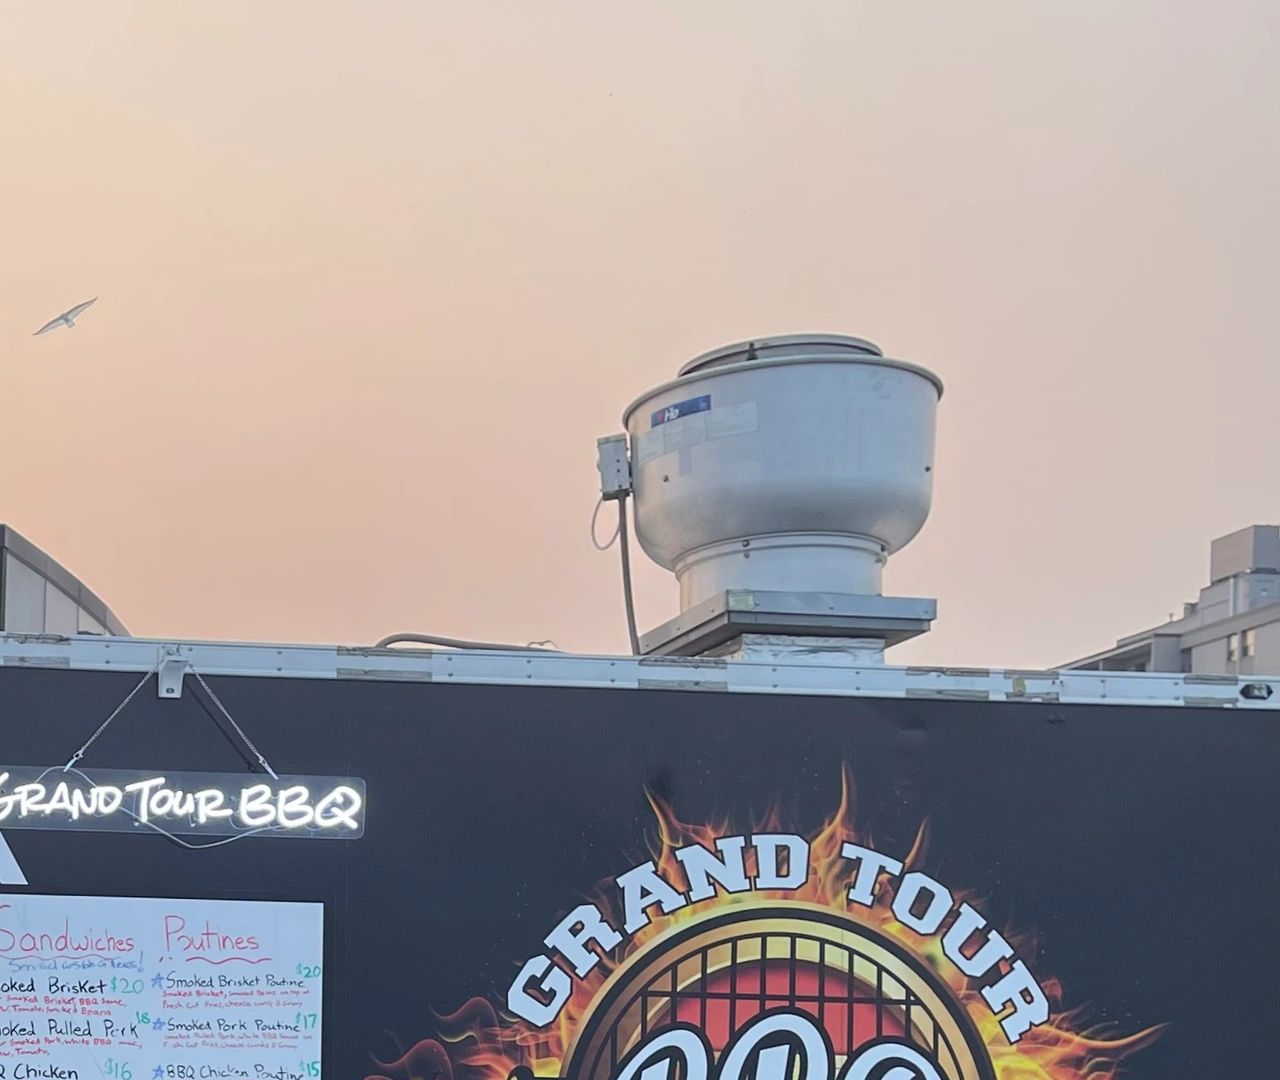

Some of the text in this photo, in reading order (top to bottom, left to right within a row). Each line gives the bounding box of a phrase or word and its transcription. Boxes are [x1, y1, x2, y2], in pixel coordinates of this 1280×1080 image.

[239, 783, 361, 829] BBQ
[164, 914, 260, 953] Poutines
[506, 832, 1052, 1046] GRAND TOUR
[48, 976, 108, 994] Brisket
[111, 975, 145, 994] $20
[166, 962, 322, 989] Smoked Brisket Poutine $20
[48, 1018, 93, 1037] Pulled
[167, 1012, 317, 1033] Smoked Pork Poutine $17
[13, 1063, 79, 1080] Chicken
[166, 1064, 195, 1080] BBQ
